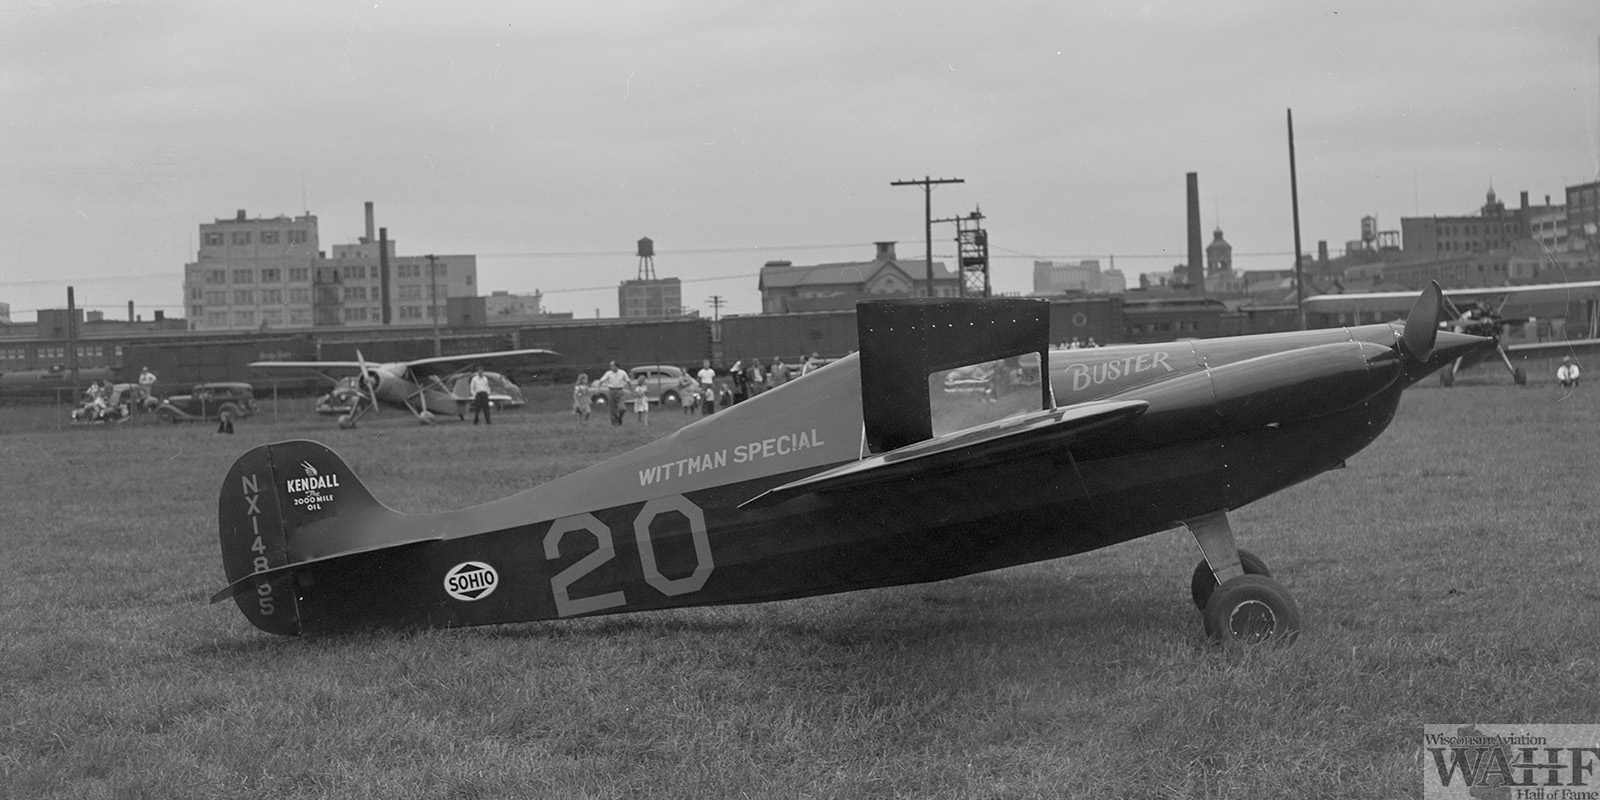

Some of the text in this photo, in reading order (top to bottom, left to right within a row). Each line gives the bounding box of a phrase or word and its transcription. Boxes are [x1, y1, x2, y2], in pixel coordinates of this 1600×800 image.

[1064, 351, 1174, 391] BUSTER
[638, 428, 825, 487] WITTMAN SPECIAL
[287, 474, 340, 493] KENDALL
[294, 497, 316, 505] 2000
[307, 503, 321, 511] OIL
[543, 494, 715, 618] 20
[449, 570, 495, 592] SOHIO
